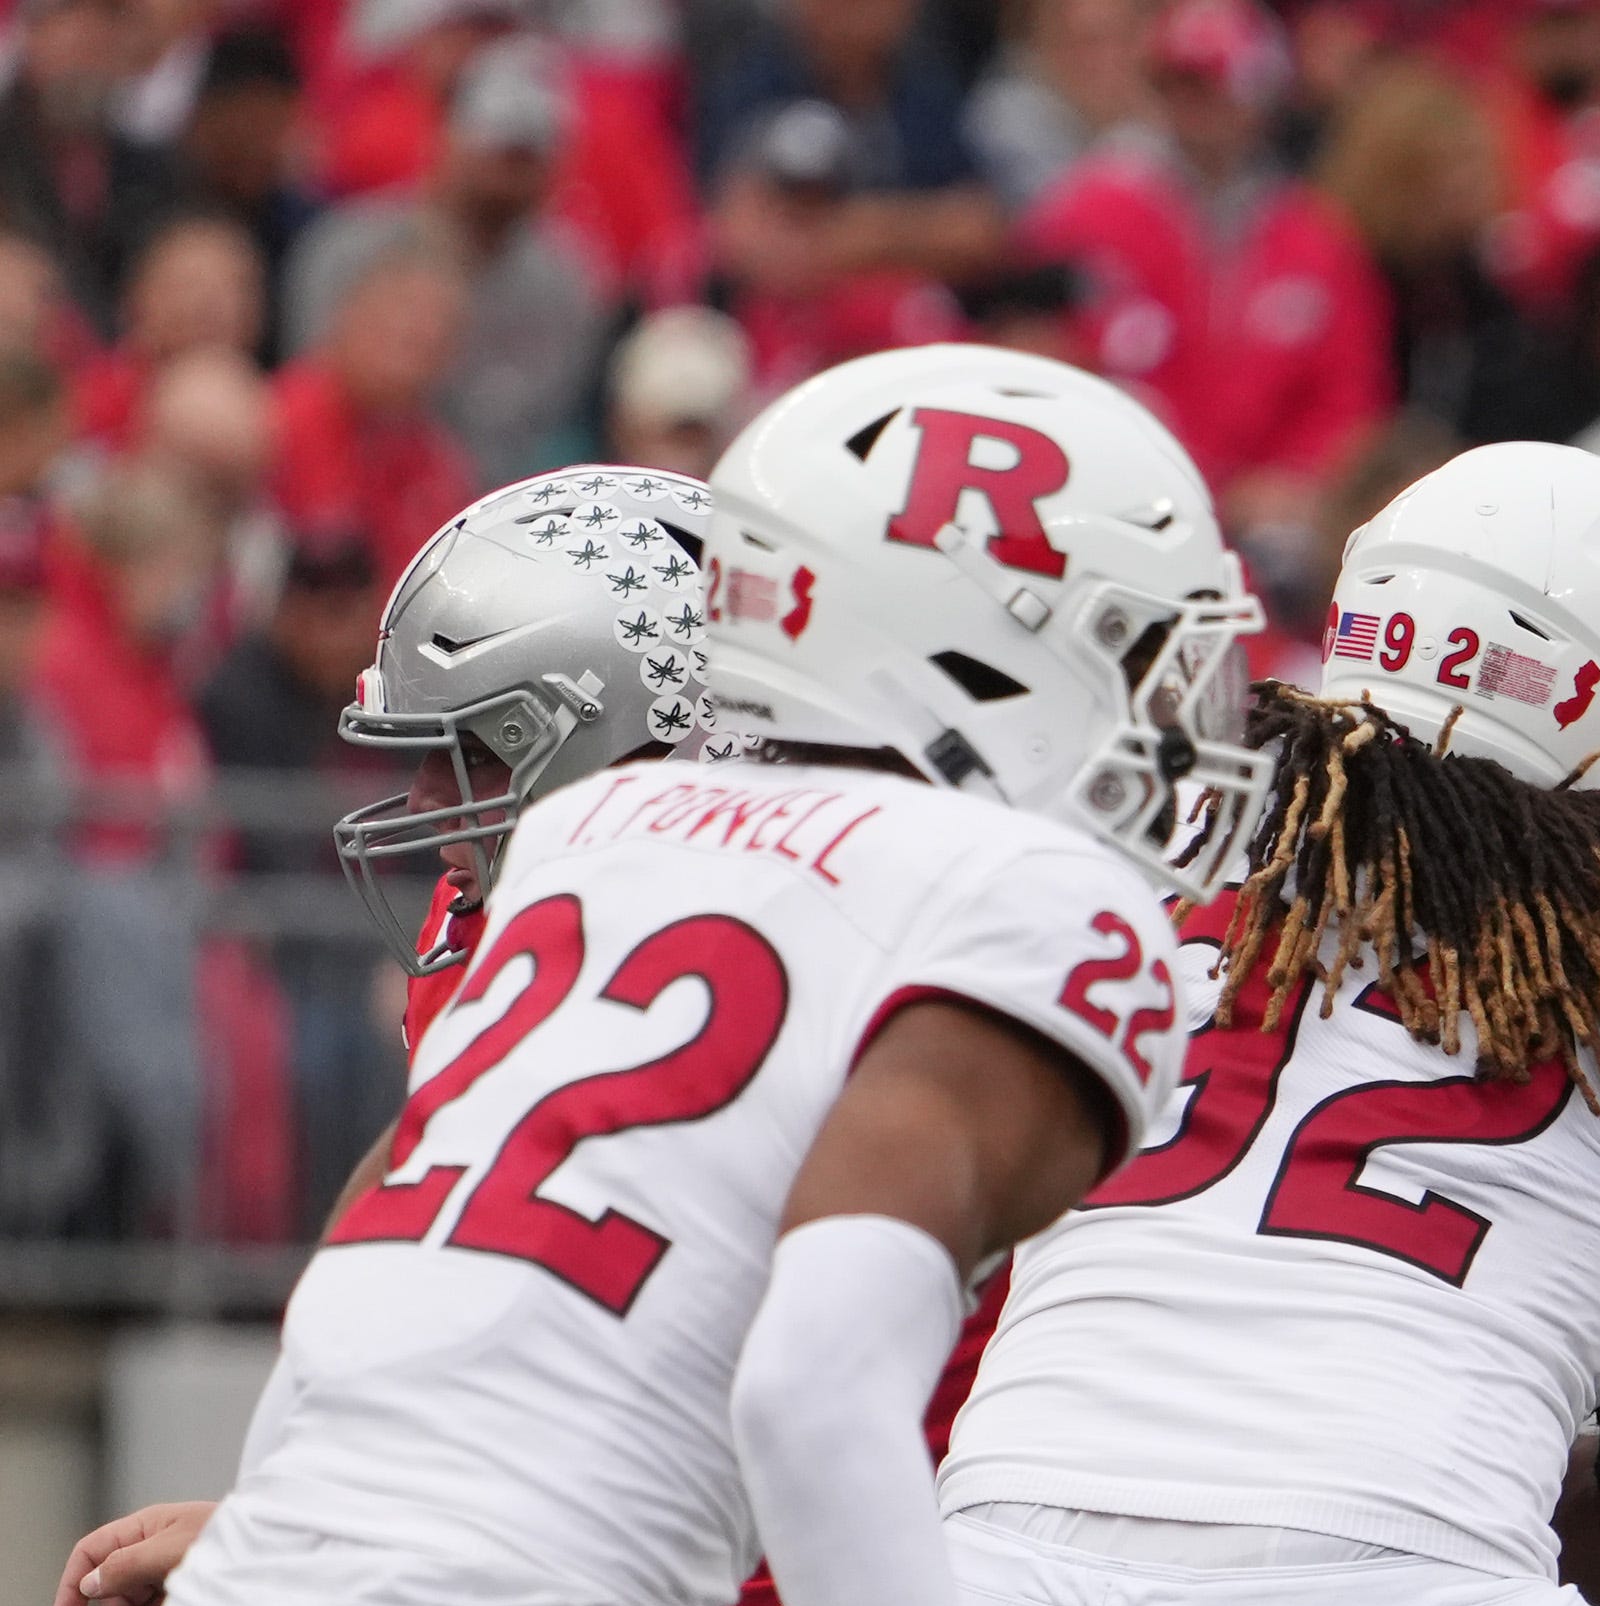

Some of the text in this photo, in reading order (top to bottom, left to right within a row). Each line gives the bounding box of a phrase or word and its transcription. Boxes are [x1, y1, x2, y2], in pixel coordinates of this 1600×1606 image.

[886, 406, 1071, 580] R
[611, 783, 882, 886] POWELL
[1058, 909, 1176, 1090] 22
[324, 892, 791, 1319] 22
